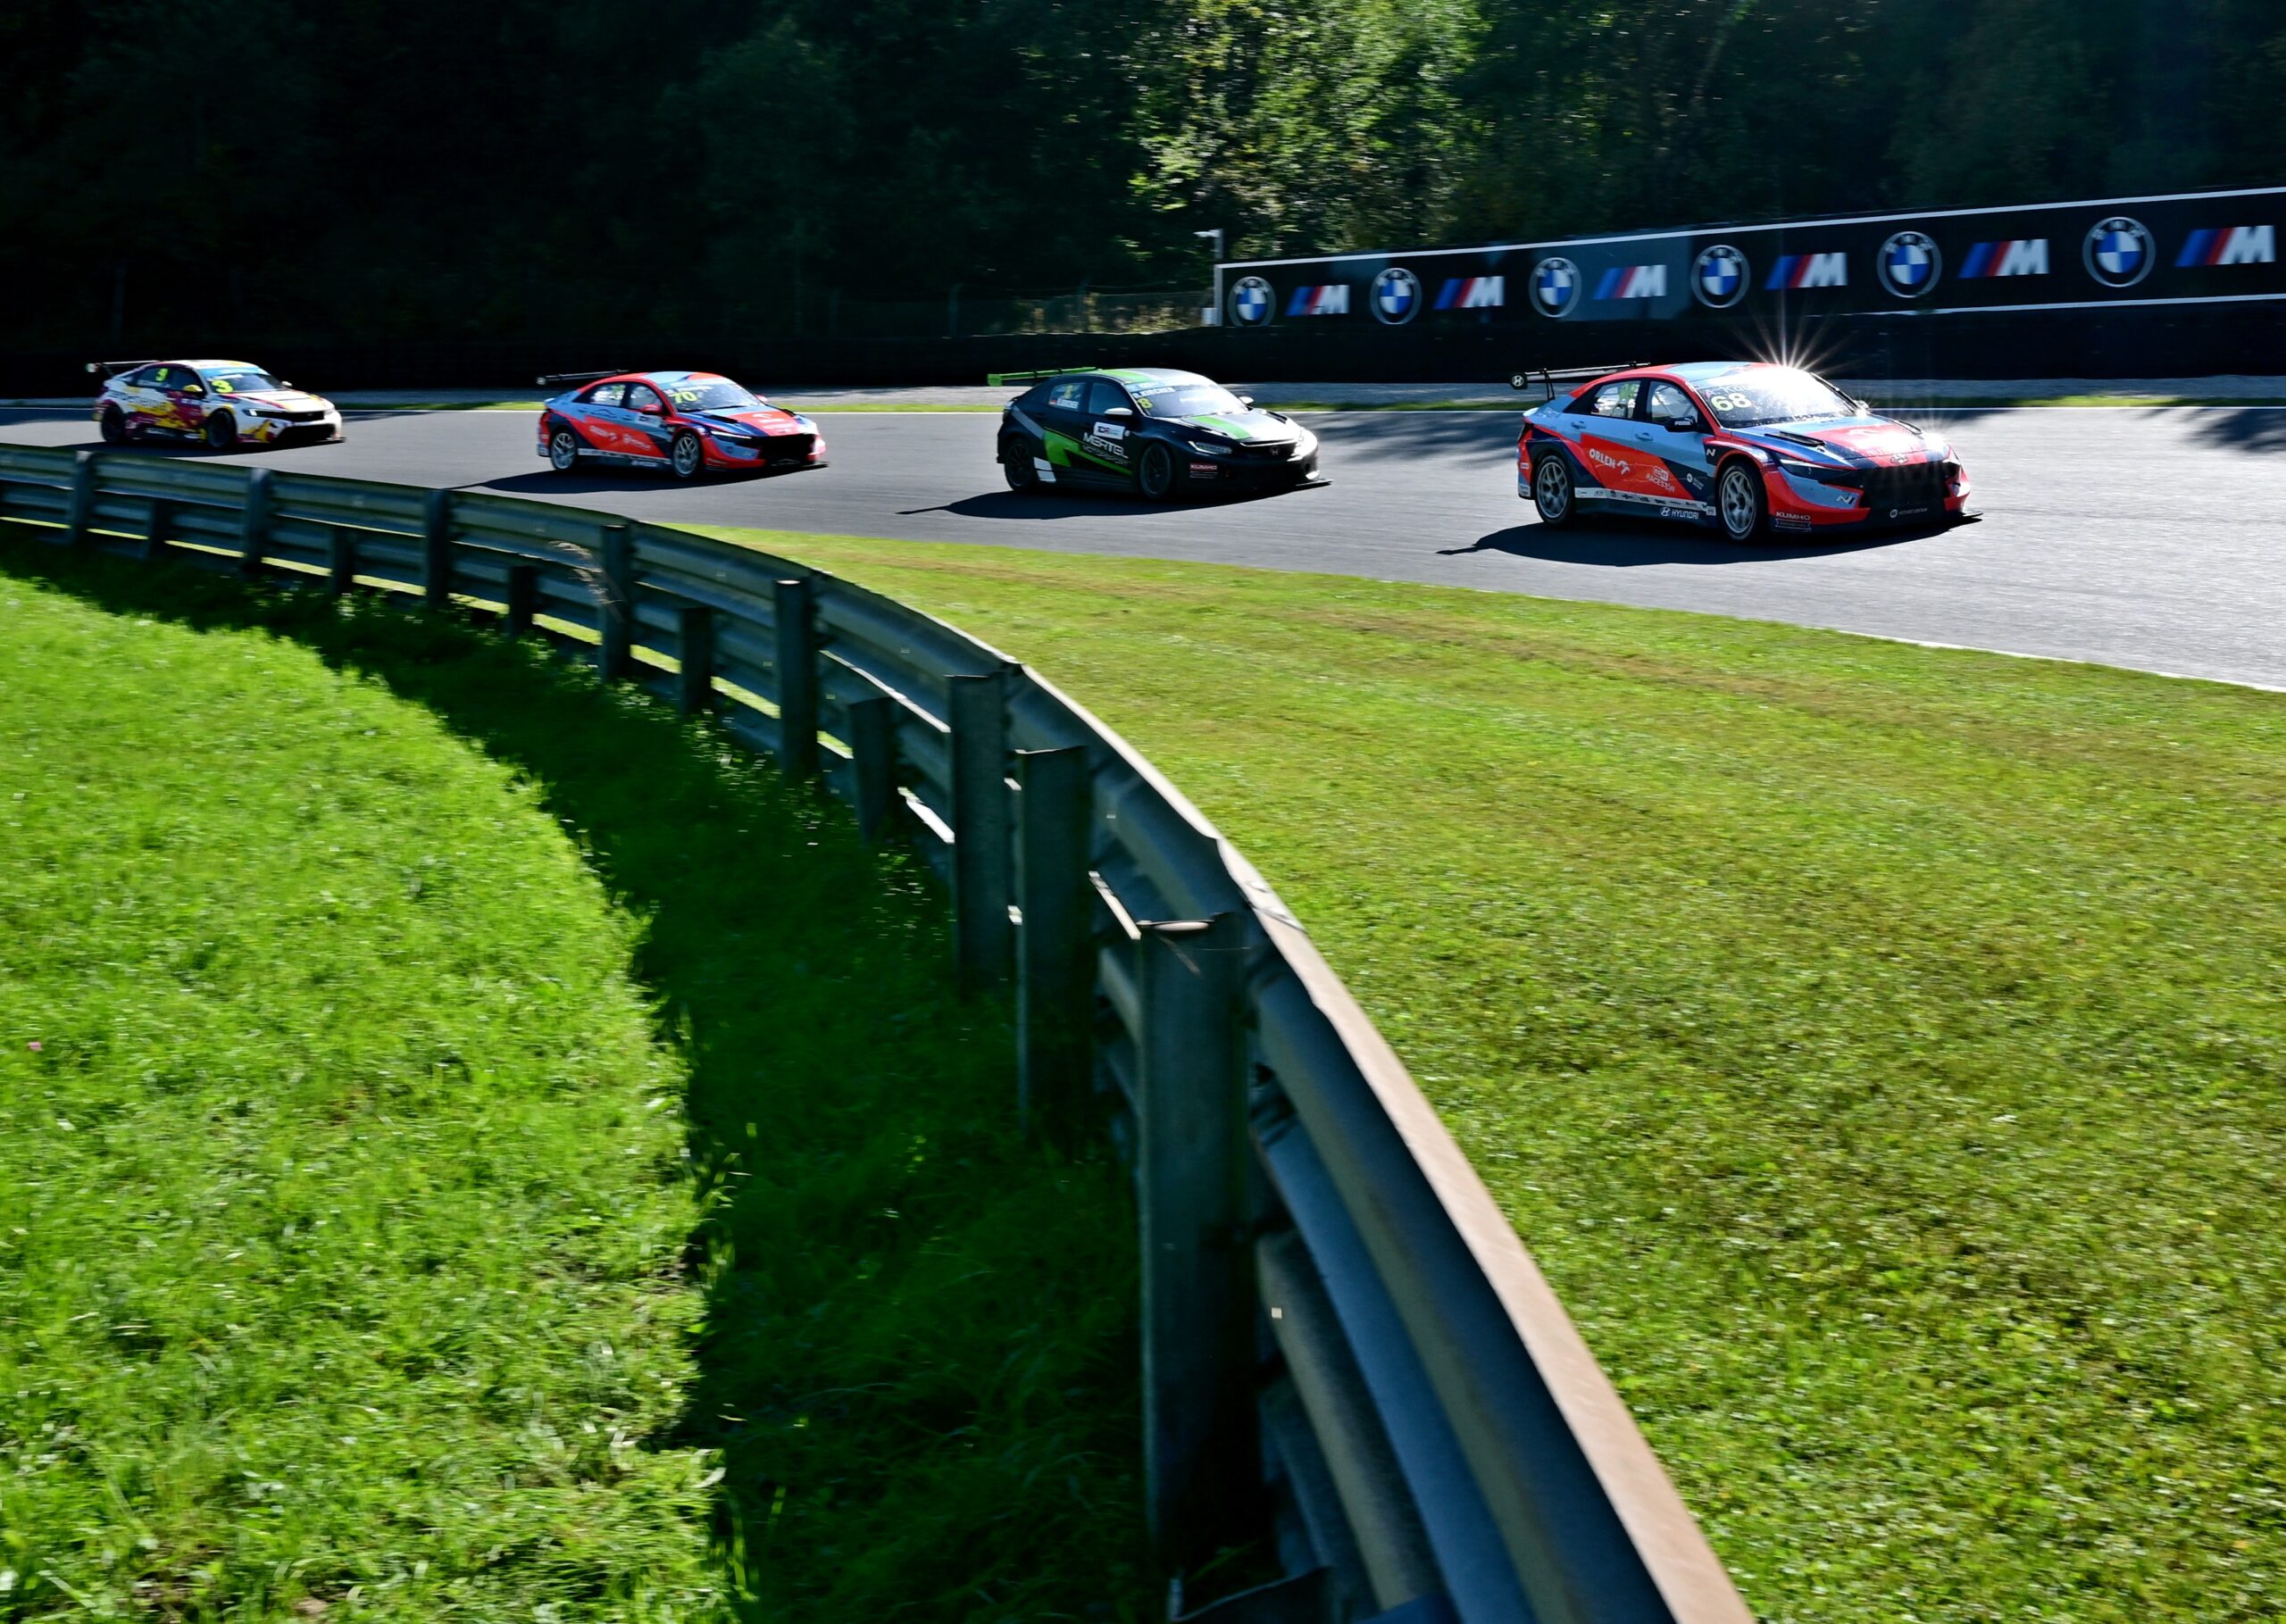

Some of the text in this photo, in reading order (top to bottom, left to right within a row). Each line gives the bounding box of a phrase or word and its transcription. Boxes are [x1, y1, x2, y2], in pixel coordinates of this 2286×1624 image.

[212, 379, 234, 394] 3
[668, 391, 698, 404] 70
[1137, 397, 1154, 409] 8
[1711, 392, 1752, 412] 68
[1082, 432, 1130, 460] MERTEL
[1589, 448, 1616, 469] ORLEN
[1671, 509, 1700, 520] HYUNDAI
[1775, 511, 1811, 521] KUMHO
